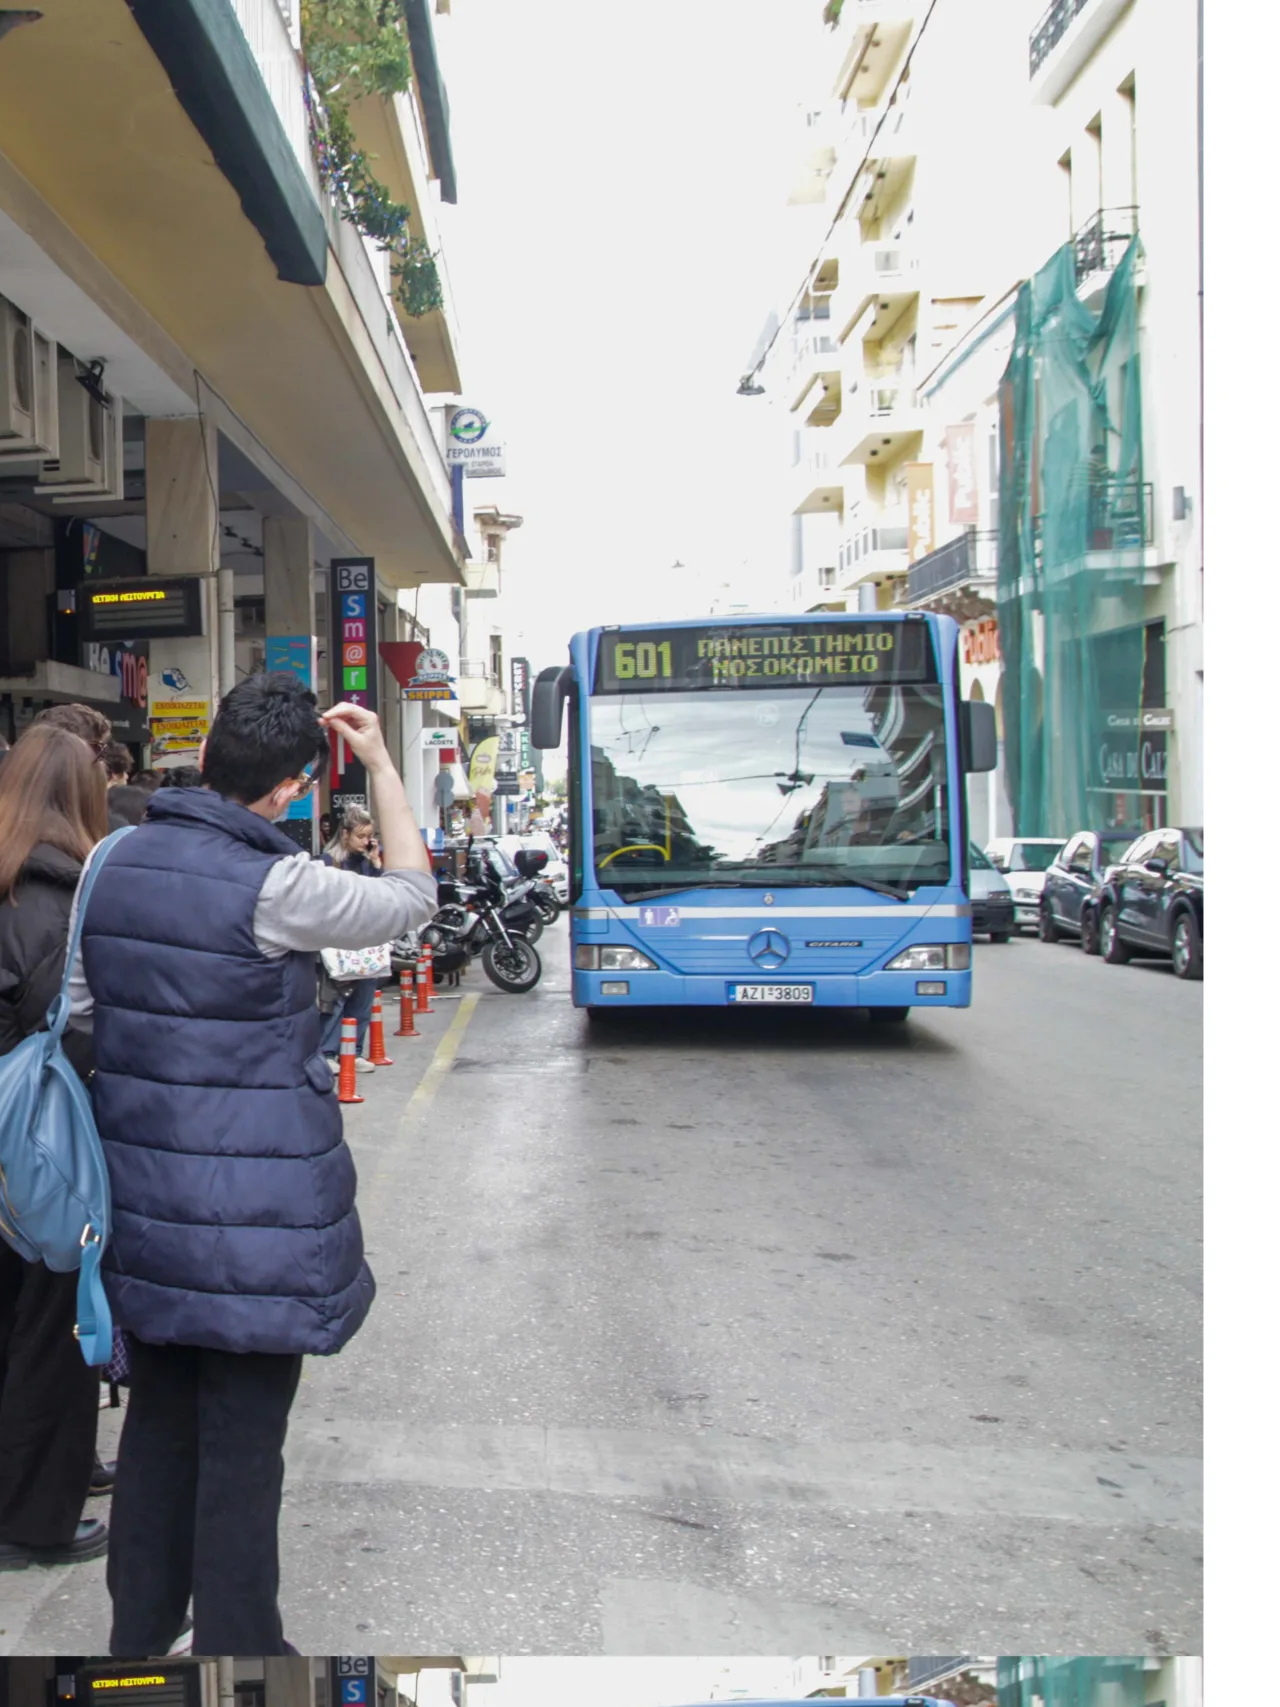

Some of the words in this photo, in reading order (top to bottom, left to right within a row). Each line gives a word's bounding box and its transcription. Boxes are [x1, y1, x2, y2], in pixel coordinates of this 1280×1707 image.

[446, 446, 502, 459] ΓΕΡΟΛΥΜΟΣ
[338, 567, 368, 590] Be
[696, 632, 894, 657] ΠΑΝΕΠΙΣΤΗΜΙΟ
[614, 641, 673, 679] 601
[711, 653, 879, 678] ΝΟΣΟΚΟΜΕΙΟ
[808, 940, 859, 948] CITARO
